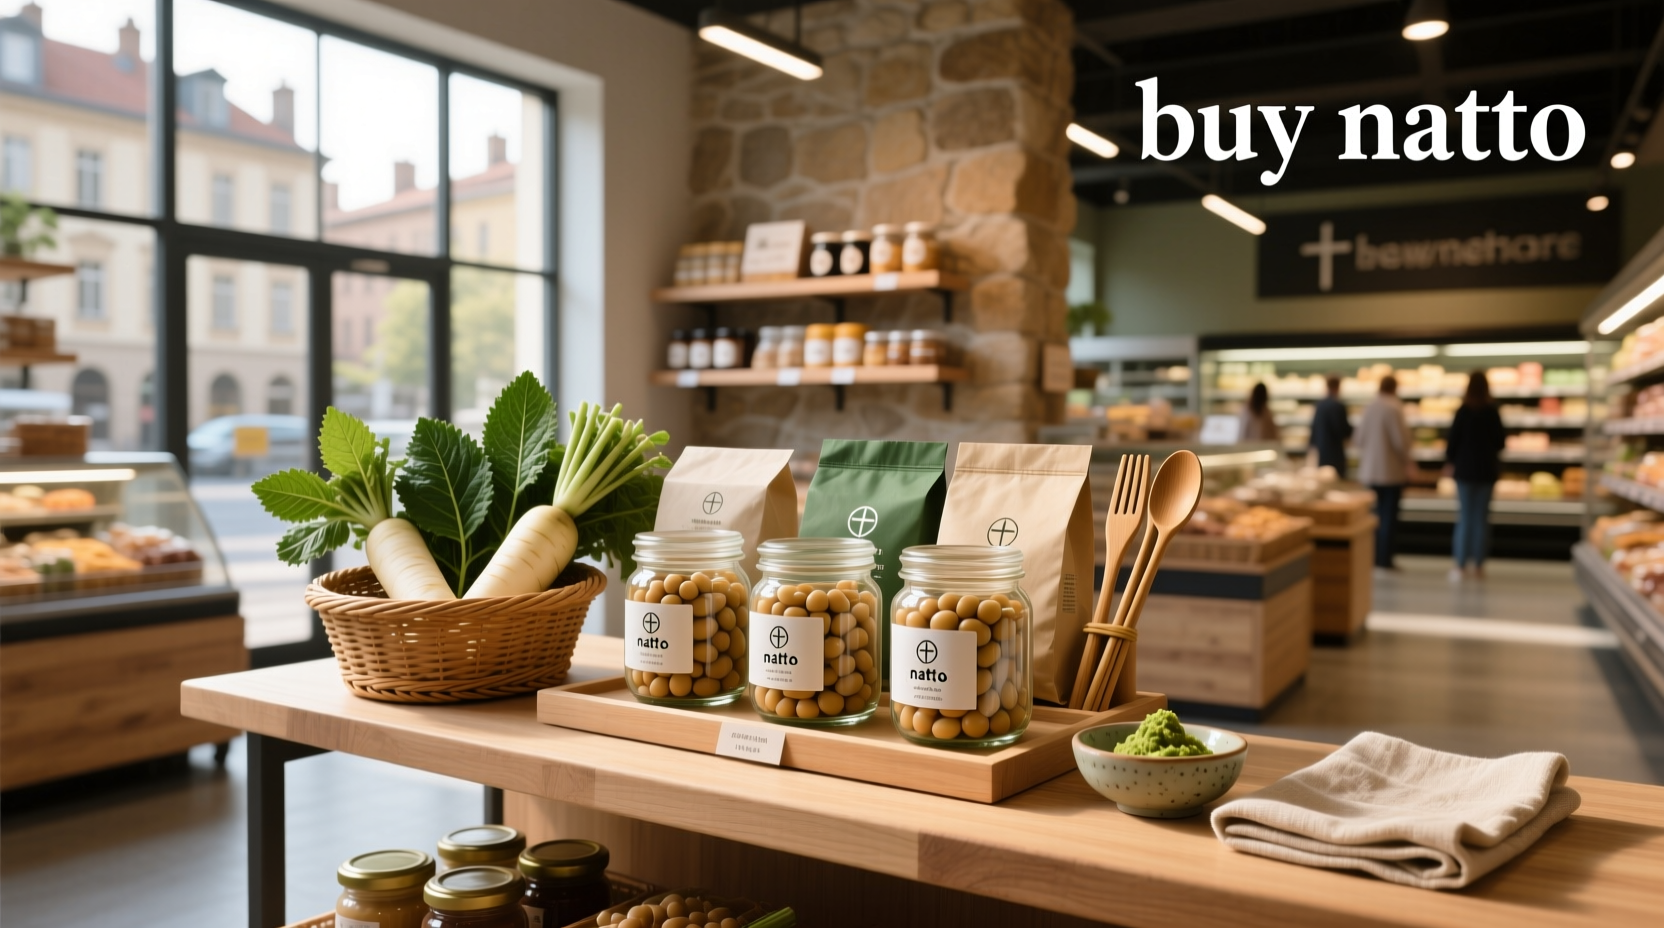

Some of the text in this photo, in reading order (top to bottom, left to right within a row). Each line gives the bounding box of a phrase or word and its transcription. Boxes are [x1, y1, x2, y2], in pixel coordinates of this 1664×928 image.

[637, 637, 669, 650] natto
[763, 652, 798, 666] natto
[910, 668, 947, 683] natto
